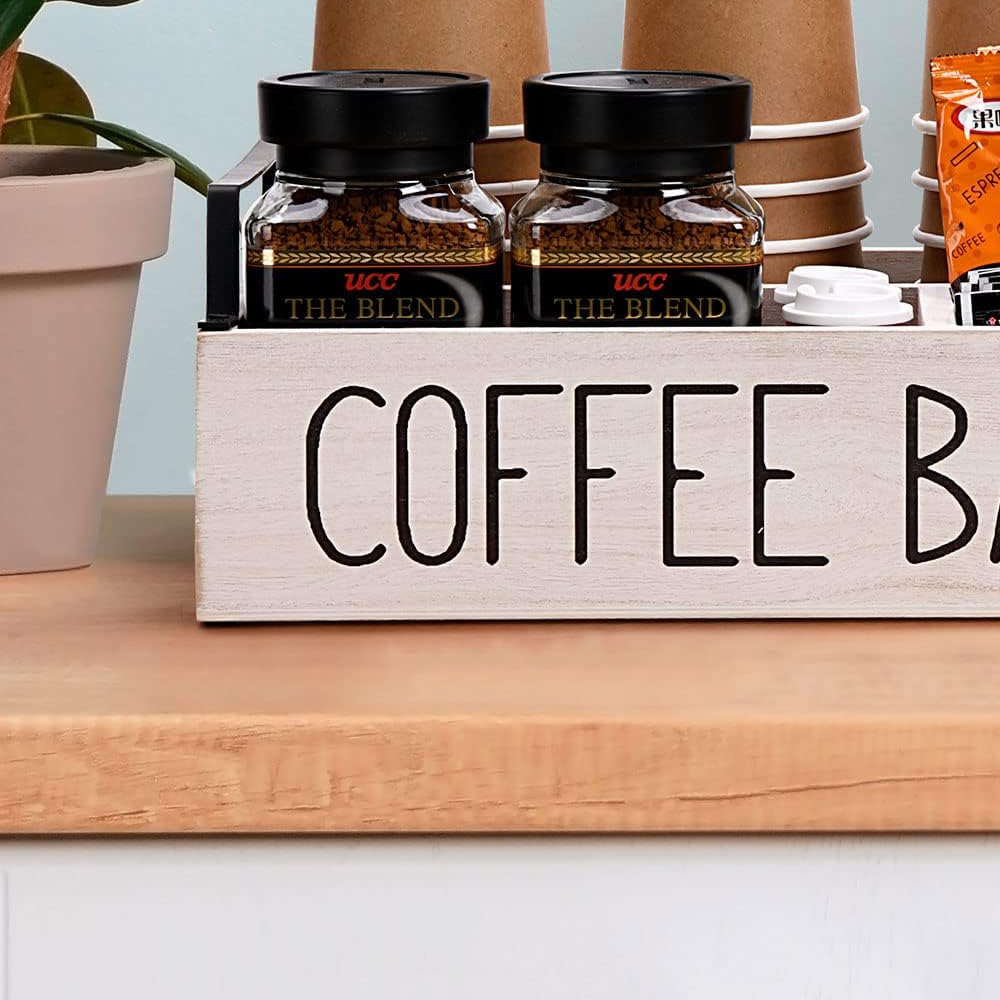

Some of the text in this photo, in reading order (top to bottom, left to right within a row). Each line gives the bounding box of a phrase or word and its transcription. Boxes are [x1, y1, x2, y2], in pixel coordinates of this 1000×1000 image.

[951, 232, 986, 259] COFFEE
[285, 297, 461, 320] THE BLEND
[553, 297, 727, 320] THE BLEND
[306, 384, 829, 567] COFFEE
